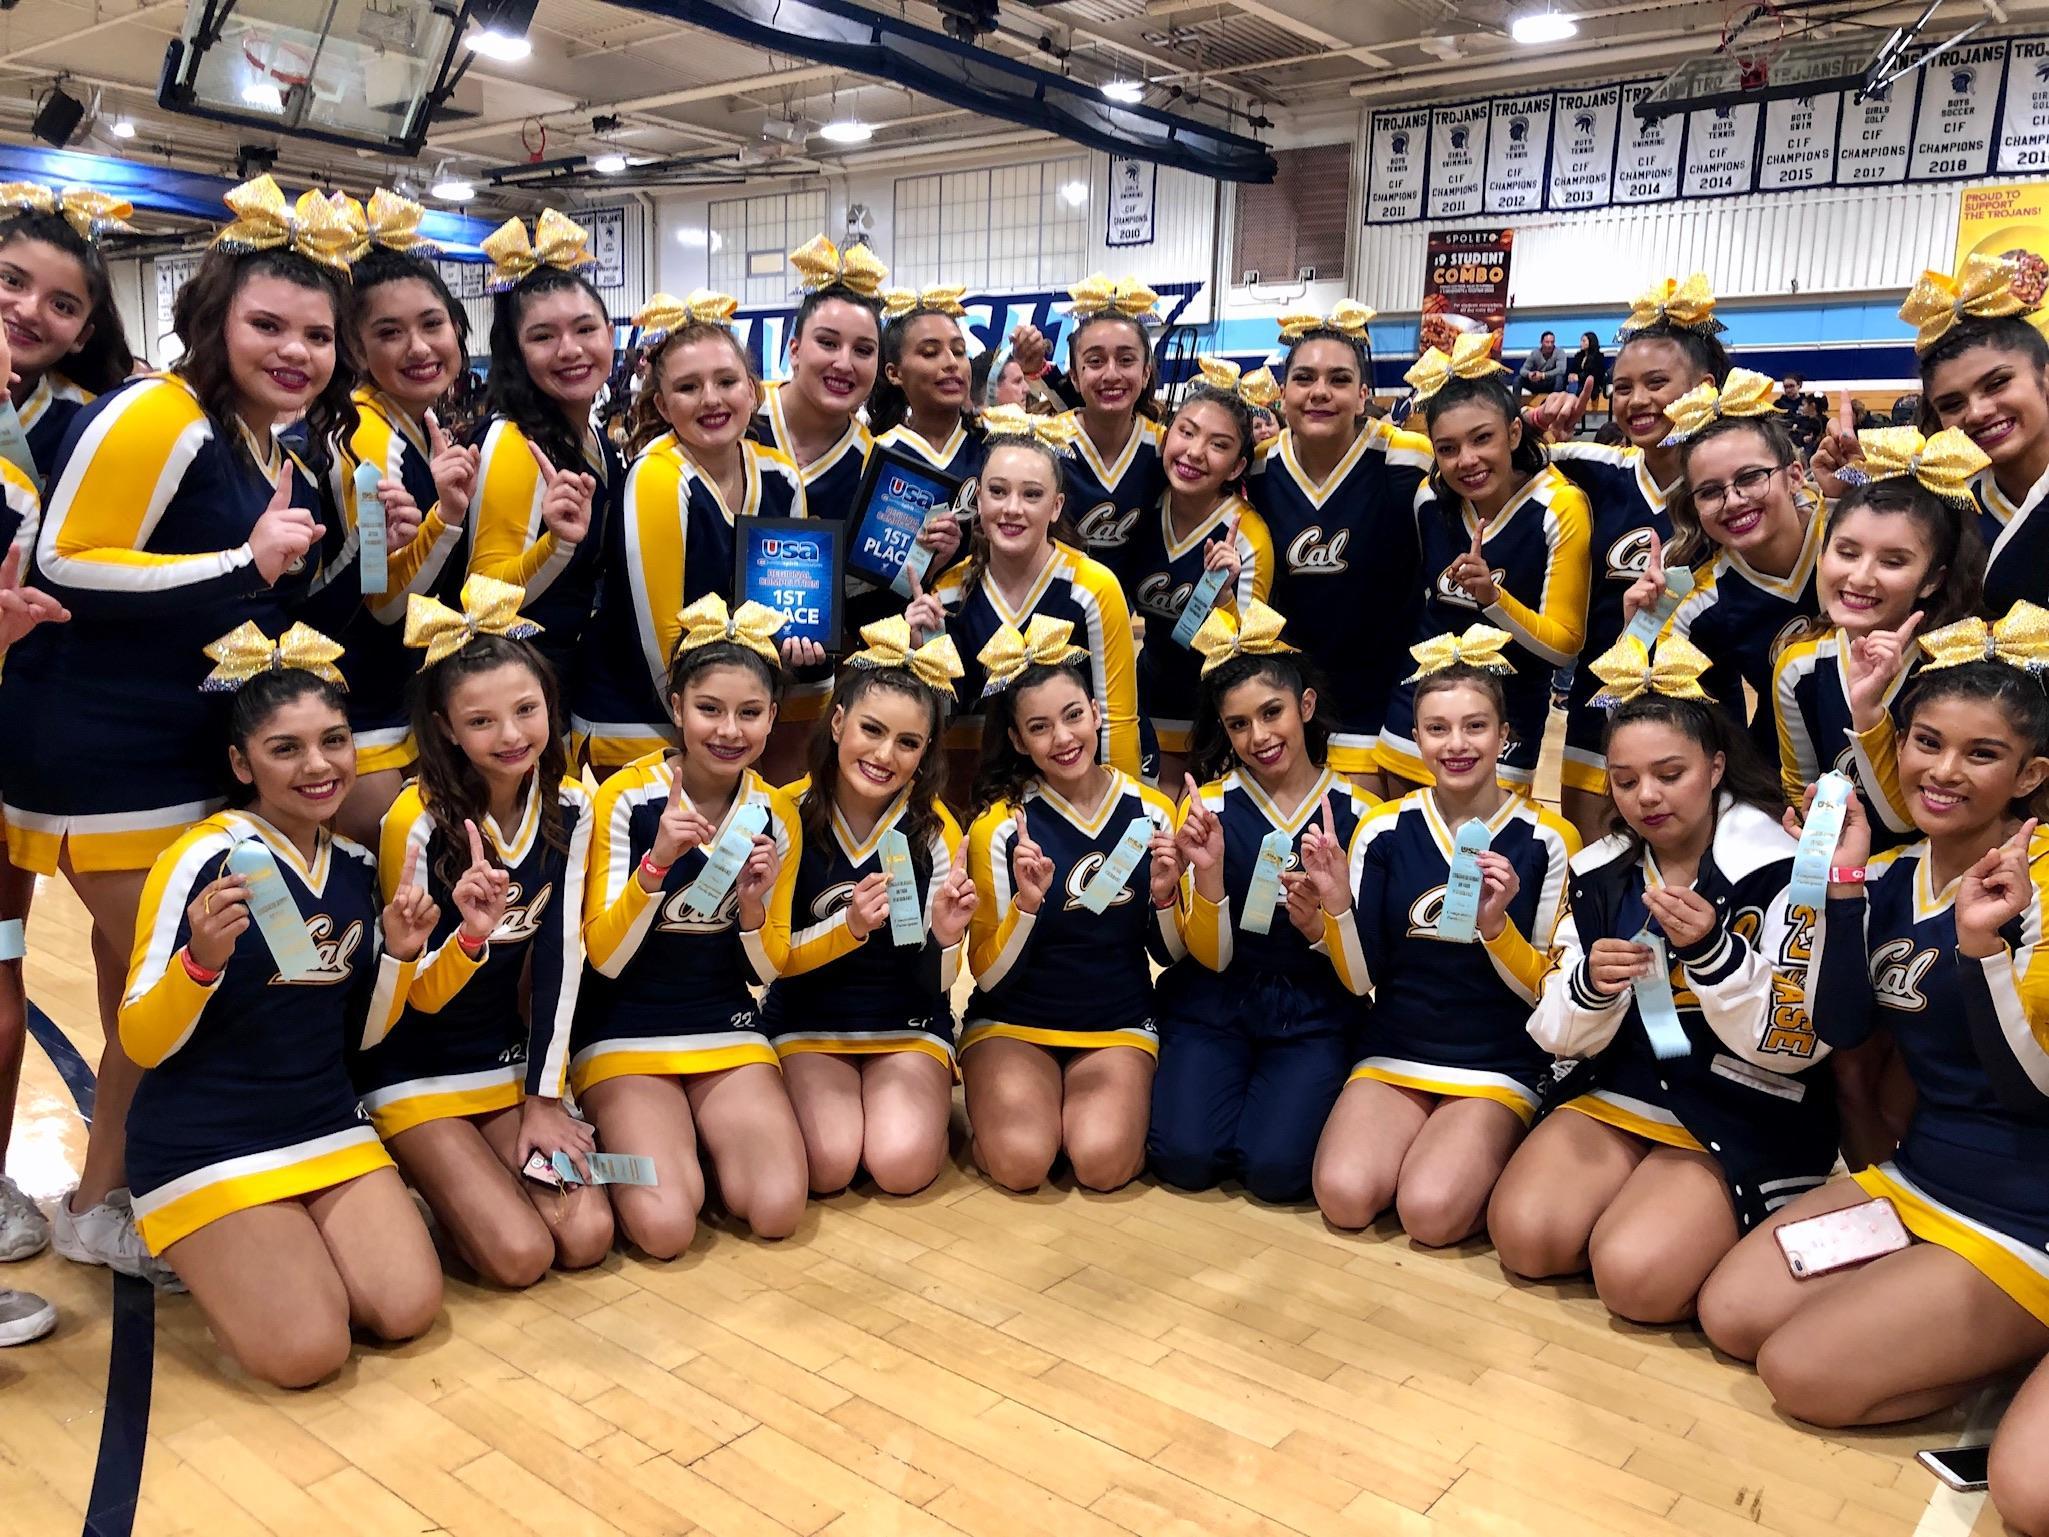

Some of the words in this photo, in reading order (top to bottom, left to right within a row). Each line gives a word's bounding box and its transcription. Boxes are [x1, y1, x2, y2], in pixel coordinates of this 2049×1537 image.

[1929, 45, 2005, 68] TROJANS
[2015, 42, 2049, 58] TRO
[1559, 90, 1618, 110] TROJANS
[2032, 92, 2049, 100] GIR
[1495, 98, 1550, 117] TROJANS
[1947, 98, 1970, 108] BOYS
[2032, 101, 2049, 110] GOL
[1435, 106, 1487, 125] TROJANS
[1865, 105, 1890, 115] GIRLS
[1941, 107, 1976, 117] SOCCER
[1376, 114, 1427, 131] TROJANS
[1791, 112, 1812, 122] BOYS
[1865, 115, 1886, 124] GOLF
[2032, 115, 2049, 126] CI
[1712, 121, 1733, 131] BOYS
[1790, 121, 1812, 132] SWIM
[1944, 122, 1966, 133] CIF
[1708, 130, 1736, 139] TENNIS
[1862, 129, 1883, 140] CIF
[2005, 134, 2049, 146] CHAMPI
[1574, 138, 1593, 147] BOYS
[1632, 138, 1665, 148] SWIMMING
[1787, 137, 1812, 149] CIF
[1919, 140, 1984, 154] CHAMPIONS
[1709, 147, 1728, 159] CIF
[1766, 149, 1829, 166] CHAMPIONS
[1841, 145, 1906, 159] CHAMPIONS
[2017, 151, 2049, 165] 201
[1572, 161, 1590, 173] CIF
[1638, 156, 1657, 167] CIF
[1689, 160, 1746, 174] CHAMPIONS
[1928, 159, 1967, 173] 2018
[1448, 174, 1465, 184] CIF
[1507, 168, 1523, 178] CIF
[1554, 172, 1607, 187] CHAMPIONS
[1619, 168, 1673, 181] CHAMPIONS
[1779, 168, 1813, 183] 2015
[1853, 167, 1886, 179] 2017
[1389, 180, 1404, 189] CIF
[1489, 179, 1537, 191] CHAMPIONS
[1699, 176, 1733, 190] 2014
[1373, 191, 1418, 202] CHAMPIONS
[1432, 183, 1479, 197] CHAMPIONS
[1565, 190, 1594, 203] 2013
[1629, 183, 1660, 197] 2014
[1965, 191, 2002, 202] PROUD
[2005, 190, 2021, 199] TO
[1441, 200, 1466, 213] 2011
[1498, 195, 1526, 208] 2012
[1964, 200, 2015, 211] SUPPORT
[1125, 204, 1137, 213] CIF
[1382, 206, 1406, 217] 2011
[1964, 211, 1986, 220] THE
[1988, 207, 2042, 219] TROJANS!
[1114, 213, 1148, 226] CHAMPIONS
[1120, 229, 1140, 239] 2010
[1445, 232, 1498, 244] SPOLETO
[1450, 251, 1505, 266] STUDENT
[1433, 266, 1504, 284] COMBO
[1075, 502, 1140, 547] Cal
[884, 527, 911, 549] 1ST
[864, 537, 907, 566] PLAC
[1286, 525, 1350, 575] Cal
[773, 589, 806, 606] 1ST
[1137, 572, 1193, 619] Cal
[782, 606, 819, 625] ACE
[1869, 937, 1940, 1012] Cal
